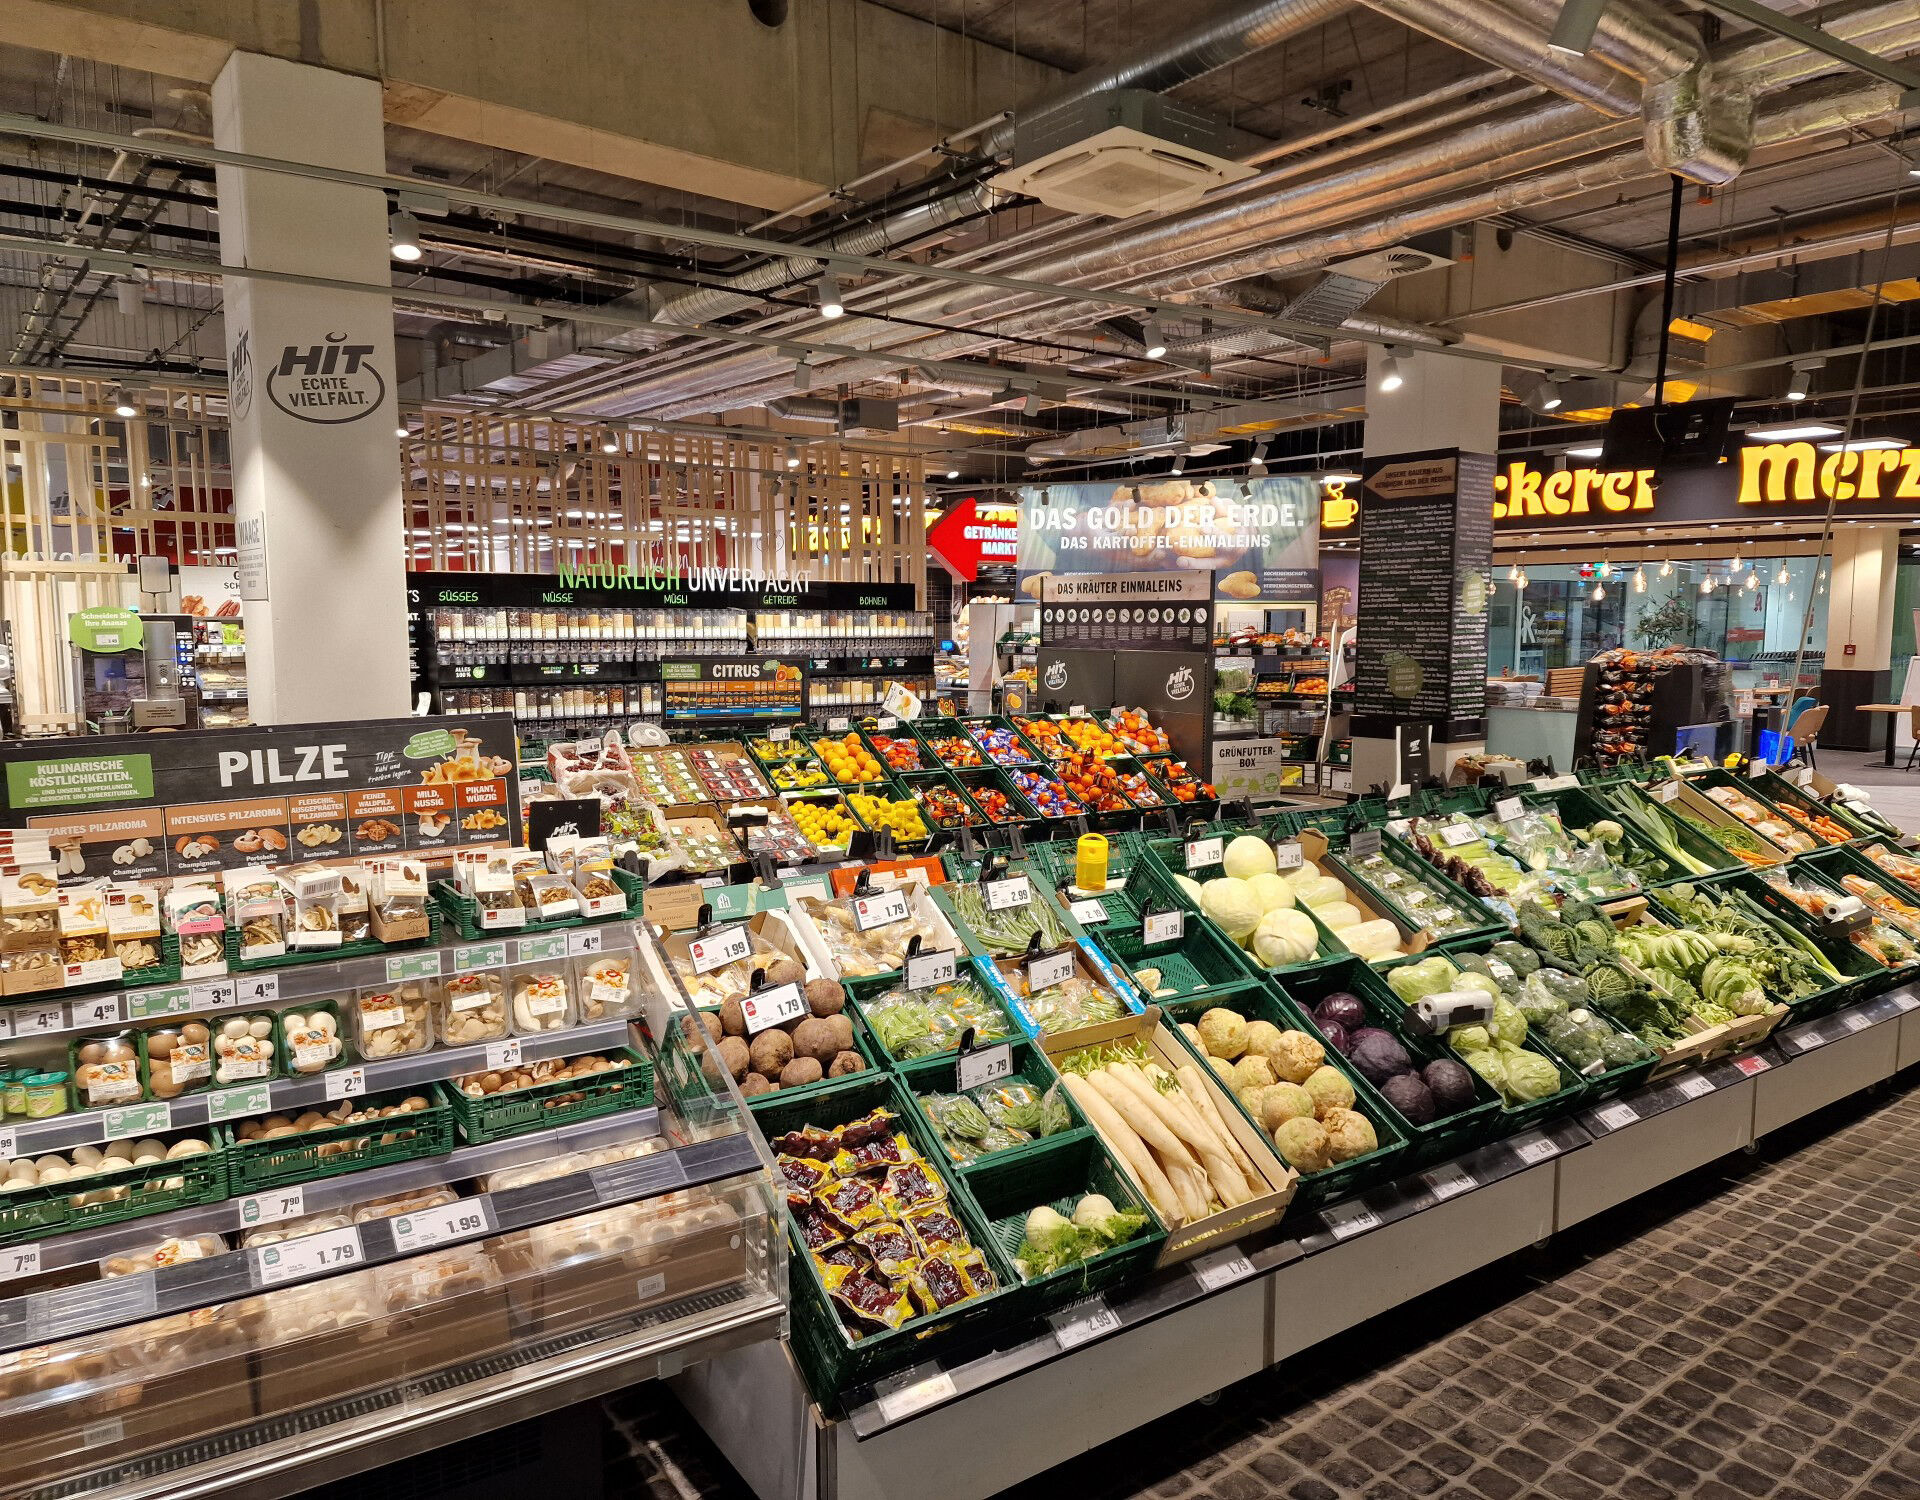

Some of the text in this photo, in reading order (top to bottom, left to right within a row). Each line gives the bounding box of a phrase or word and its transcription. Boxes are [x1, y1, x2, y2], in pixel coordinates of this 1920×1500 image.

[301, 378, 348, 390] ECHTE
[289, 391, 369, 407] VIELFALT.
[1030, 503, 1305, 531] DAS GOLD DER ERDE.
[239, 519, 260, 546] WAAGE
[964, 524, 1017, 540] GETRÄNKE
[982, 542, 1017, 555] MARKT
[1060, 534, 1271, 550] DAS KARTOFFEL-EINMALEINS
[558, 562, 680, 591] NATÜRLICH
[688, 566, 811, 593] UNVERPACKT
[1057, 579, 1183, 595] DAS KRÄUTER EINMALEINS
[439, 590, 478, 602] SÜSSES
[543, 592, 573, 603] NÜSSE
[663, 592, 688, 604] MÜSLI
[763, 595, 797, 605] GETREIDE
[860, 596, 887, 606] BOHNEN
[81, 612, 131, 620] Schneiden Sie
[101, 619, 127, 627] Ananas
[712, 664, 760, 678] CITRUS
[1219, 746, 1276, 758] GRÜNFUTTER-
[37, 760, 124, 775] KULINARISCHE
[218, 744, 349, 787] PILZE
[1240, 758, 1256, 768] BOX
[29, 771, 133, 787] KÖSTLICHKEITEN.
[83, 784, 133, 792] EMPFEHLUNGEN
[416, 789, 440, 798] MILD,
[465, 784, 497, 794] PIKANT,
[25, 795, 39, 803] FÜR
[298, 797, 336, 806] FLEISCHIG,
[363, 792, 386, 800] FEINER
[466, 793, 497, 803] WÜRZIG
[291, 803, 344, 814] AUSGEPRÄGTES
[298, 811, 338, 820] PILZAROMA
[355, 805, 396, 815] GESCHMACK
[171, 808, 283, 826] INTENSIVES PILZAROMA
[47, 819, 148, 837] ZARTES PILZAROMA
[303, 850, 340, 858] Austernpilze
[113, 866, 157, 876] Champignons
[178, 860, 221, 869] Champignons
[1011, 889, 1028, 902] 2.99
[886, 903, 905, 918] 1.79
[1165, 924, 1178, 935] 1.39
[583, 936, 599, 951] 4.99
[723, 942, 746, 958] 1.99
[933, 965, 953, 980] 2.79
[1053, 965, 1070, 979] 2.79
[211, 988, 232, 1004] 3.99
[255, 982, 275, 998] 4.99
[167, 994, 190, 1011] 4.99
[777, 999, 800, 1016] 1.79
[94, 1004, 115, 1020] 4.99
[503, 1048, 519, 1064] 2.79
[987, 1060, 1008, 1077] 2.79
[344, 1076, 362, 1093] 2.79
[247, 1093, 267, 1111] 2.69
[146, 1111, 168, 1129] 2.69
[280, 1196, 300, 1215] 7.90
[446, 1214, 482, 1234] 1.99
[317, 1244, 355, 1265] 1.79
[14, 1253, 36, 1272] 7.90
[1228, 1259, 1248, 1276] 1.79
